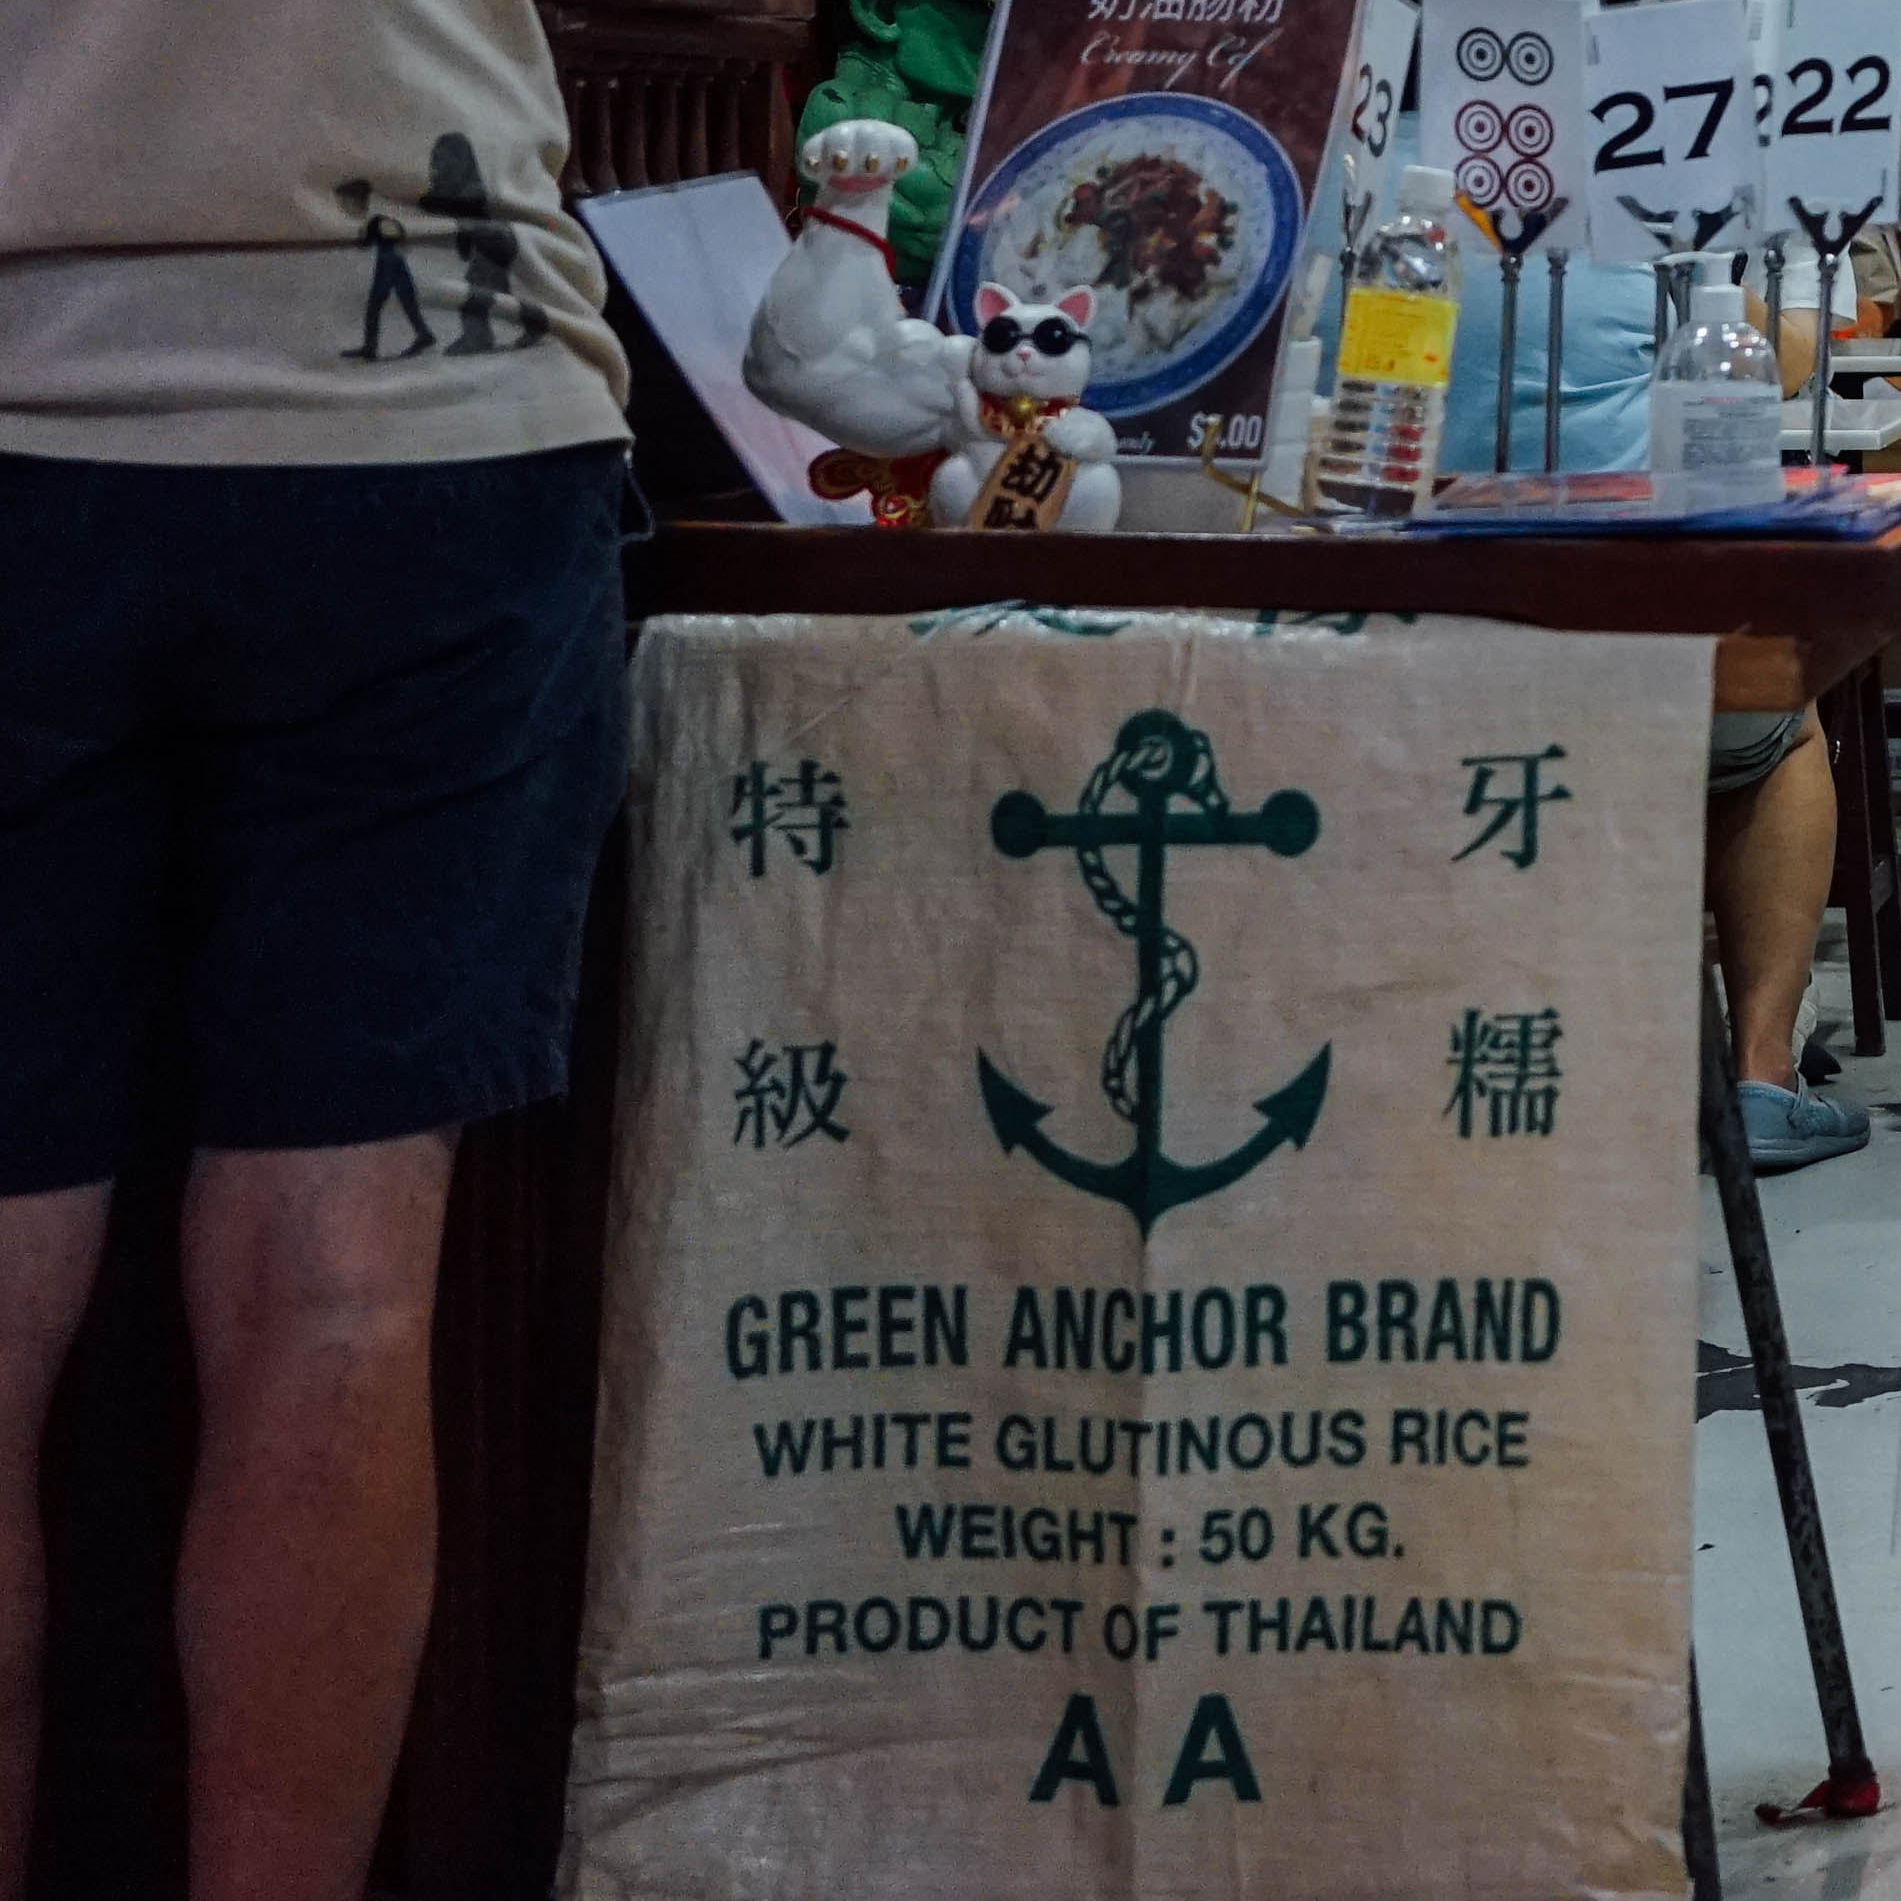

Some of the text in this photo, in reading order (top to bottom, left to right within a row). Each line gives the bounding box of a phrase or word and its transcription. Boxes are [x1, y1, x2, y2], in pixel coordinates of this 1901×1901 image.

[1080, 29, 1198, 91] Creamy
[1781, 56, 1893, 136] 22
[1351, 64, 1392, 157] 23
[1590, 78, 1735, 174] 27
[730, 759, 853, 1149] 特級
[1447, 744, 1572, 1139] 牙糯
[726, 1277, 1561, 1381] GREEN ANCHOR BRAND
[752, 1410, 1530, 1477] WHITE GLUTINOUS RICE
[895, 1505, 1139, 1567] WEIGHT
[1200, 1507, 1273, 1565] 50
[1298, 1505, 1405, 1560] KG.
[756, 1598, 1524, 1661] PRODUCT OF THAILAND
[1028, 1695, 1262, 1807] A A
